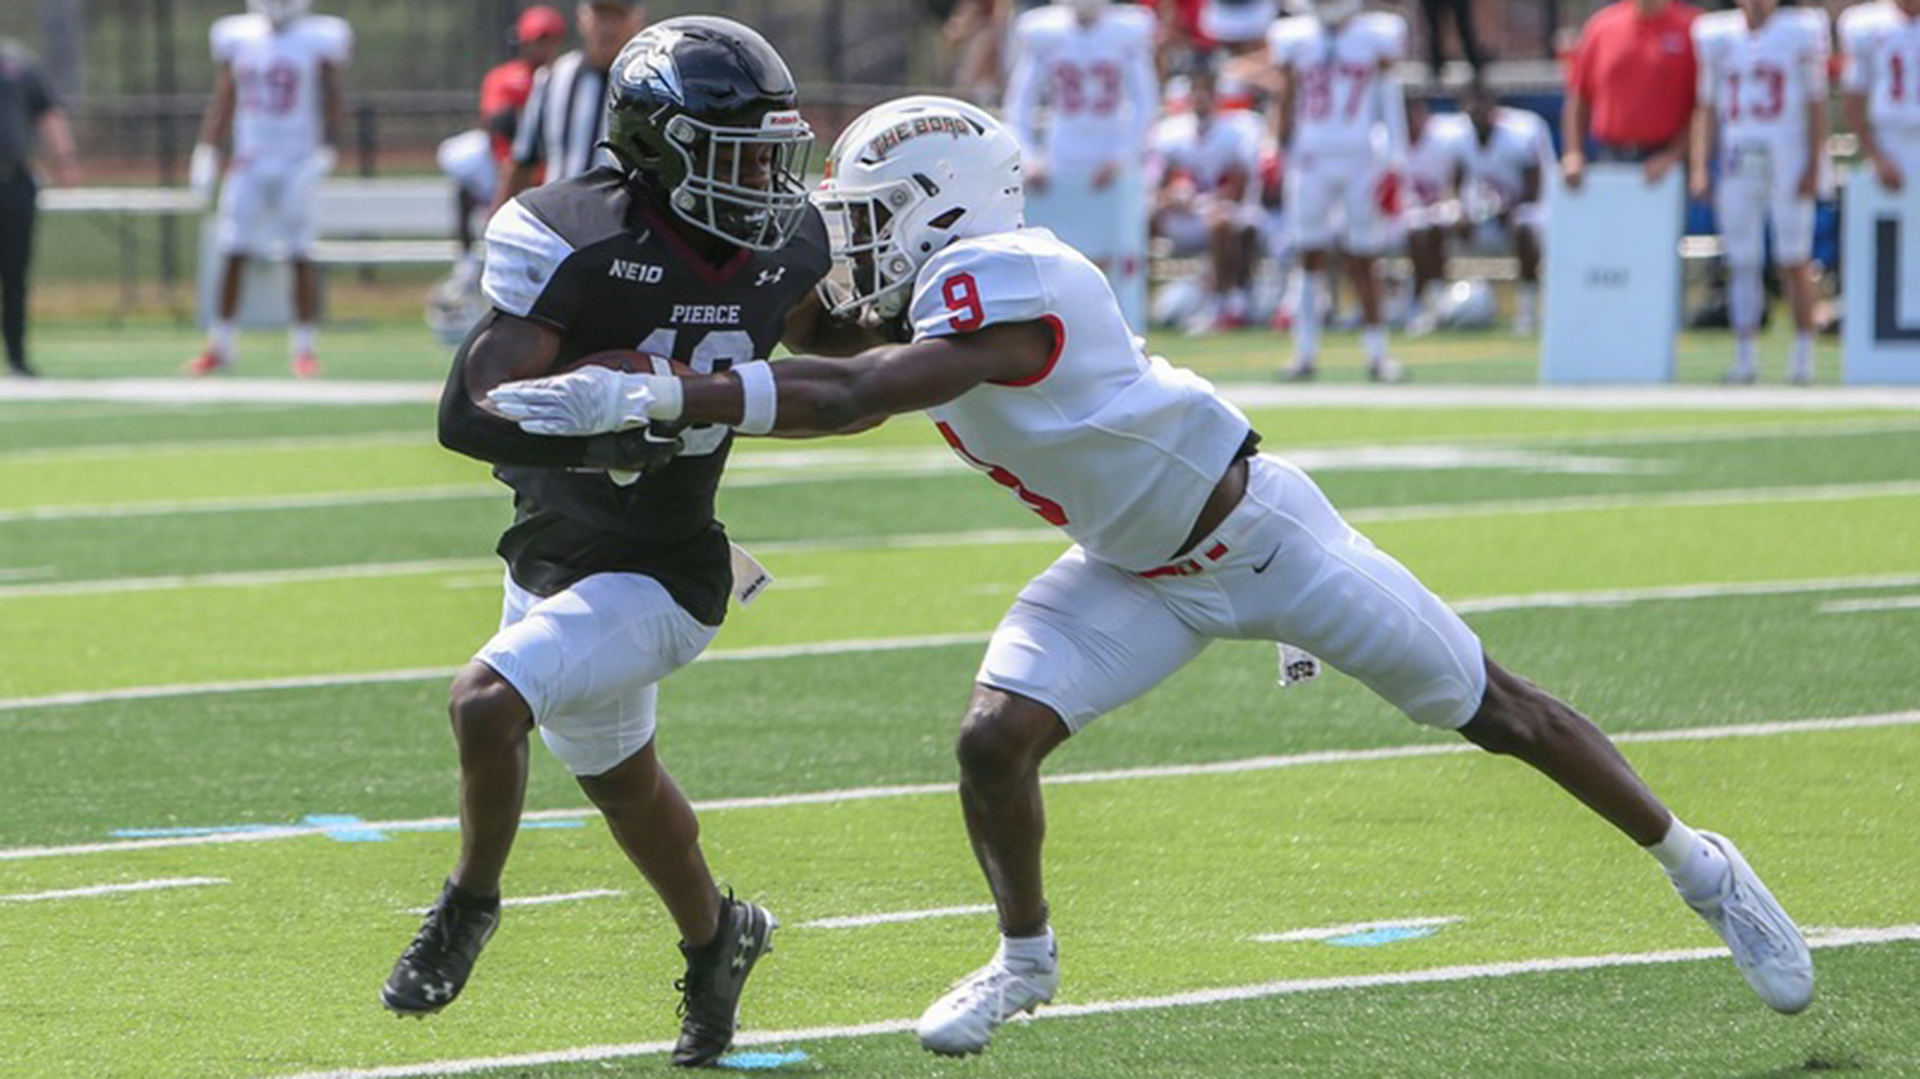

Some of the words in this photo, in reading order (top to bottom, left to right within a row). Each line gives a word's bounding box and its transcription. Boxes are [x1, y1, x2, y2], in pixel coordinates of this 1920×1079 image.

[1728, 66, 1784, 121] 13
[870, 121, 914, 157] THE
[914, 116, 969, 138] BORO
[669, 304, 741, 324] PIERCE
[942, 271, 985, 333] 9
